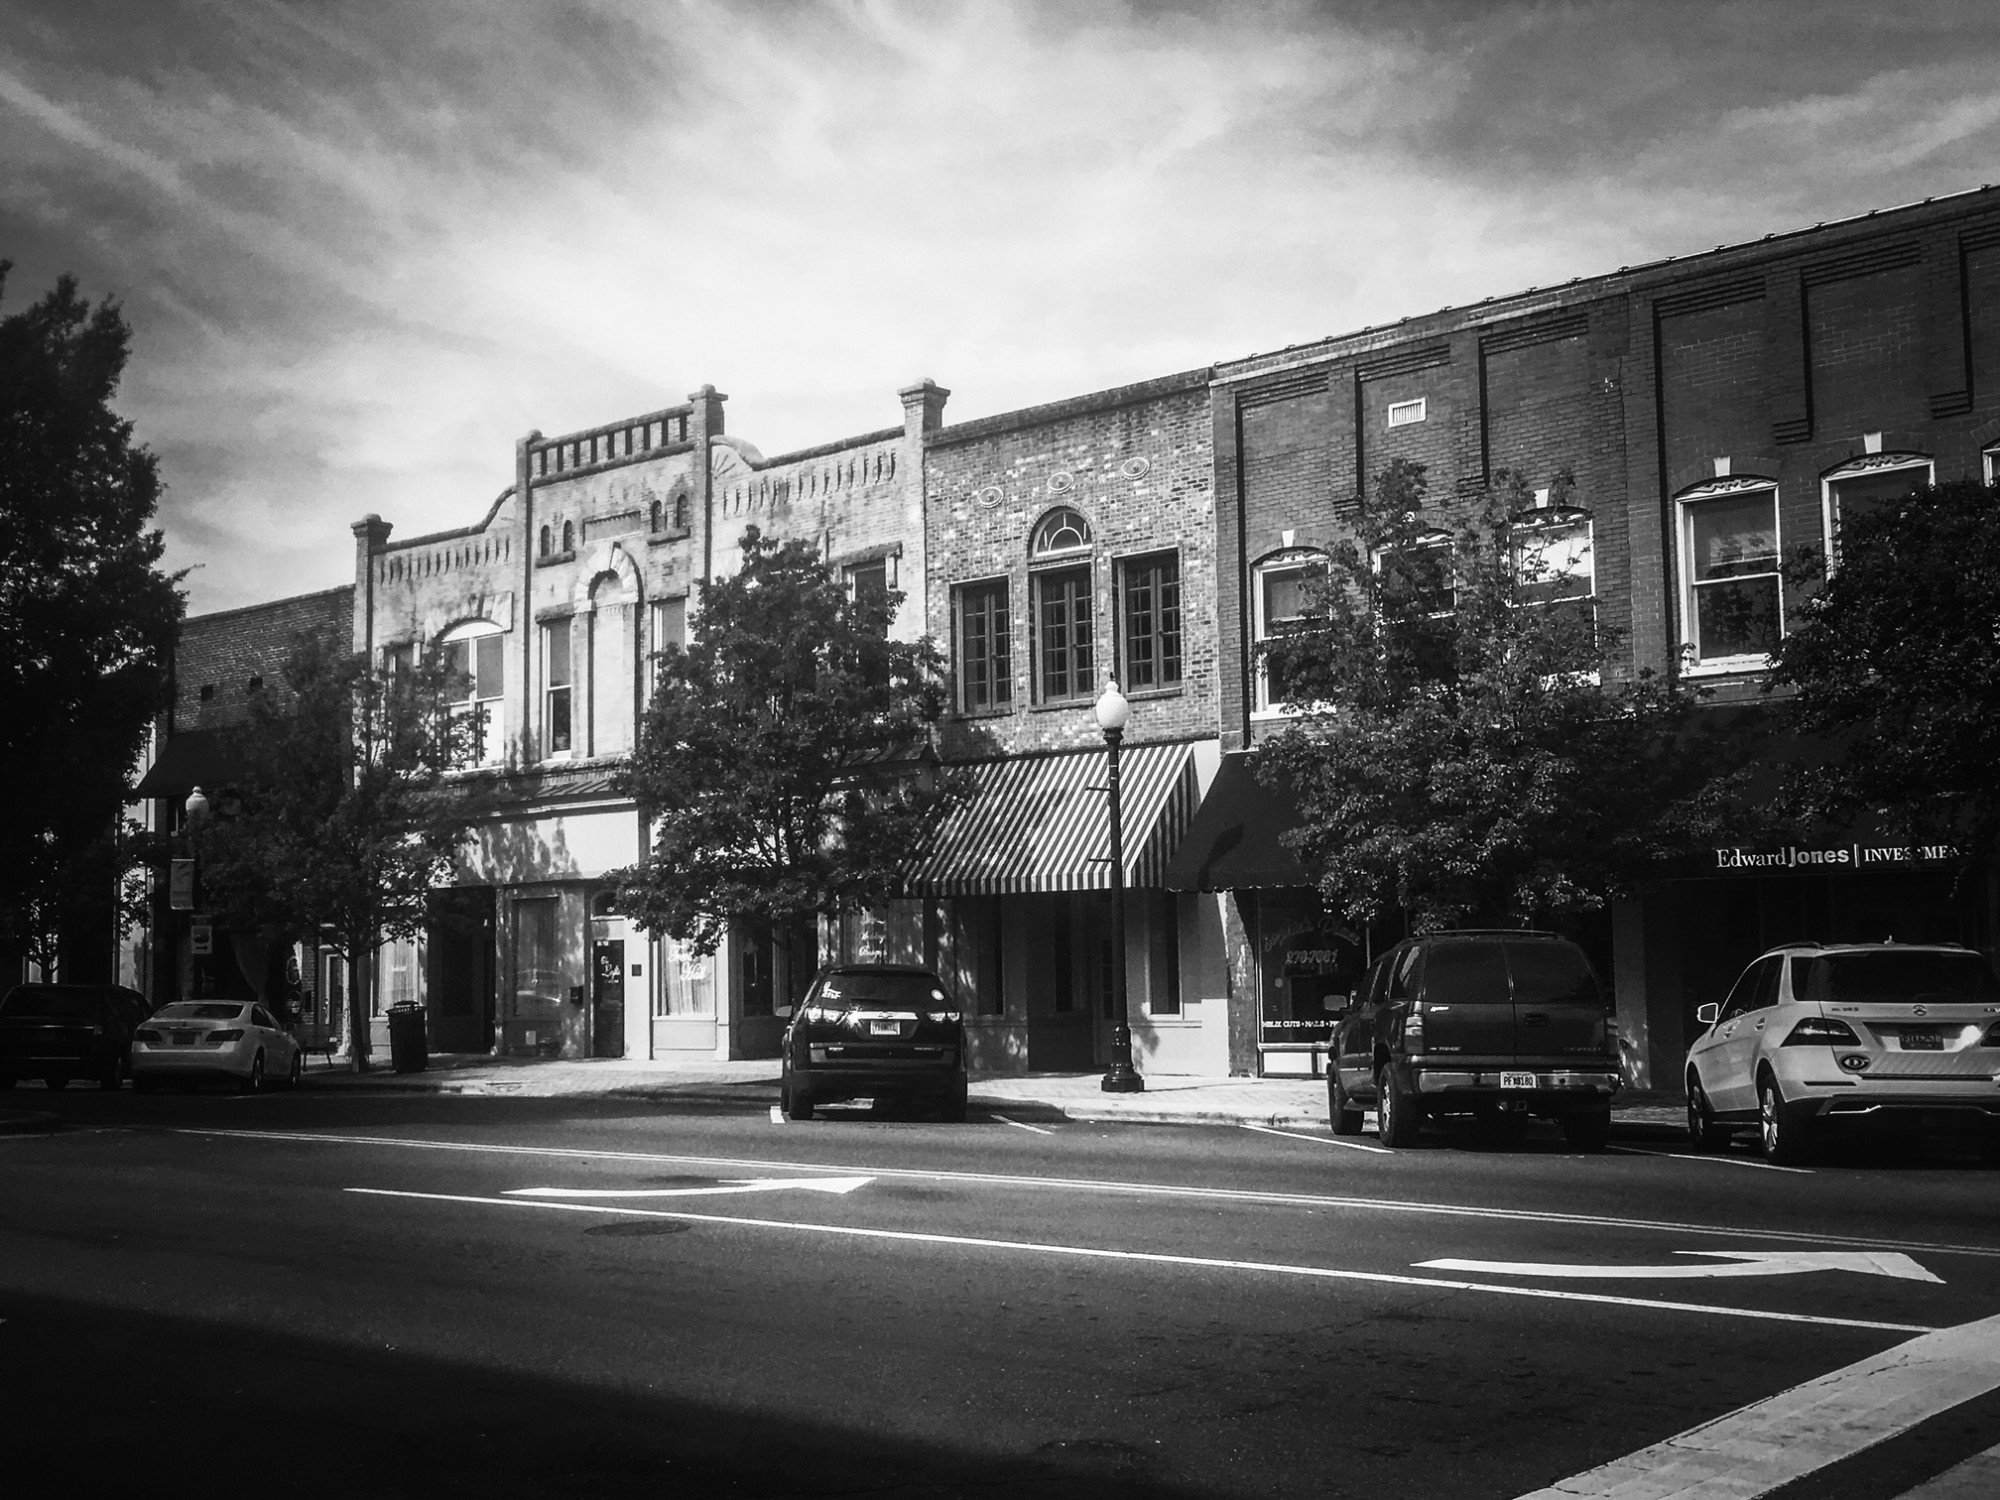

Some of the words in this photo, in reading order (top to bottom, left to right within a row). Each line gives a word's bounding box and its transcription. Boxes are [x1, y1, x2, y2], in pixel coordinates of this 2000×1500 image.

[1715, 847, 1787, 868] Edward
[1788, 846, 1850, 867] Jones
[1863, 845, 1972, 862] INVESME
